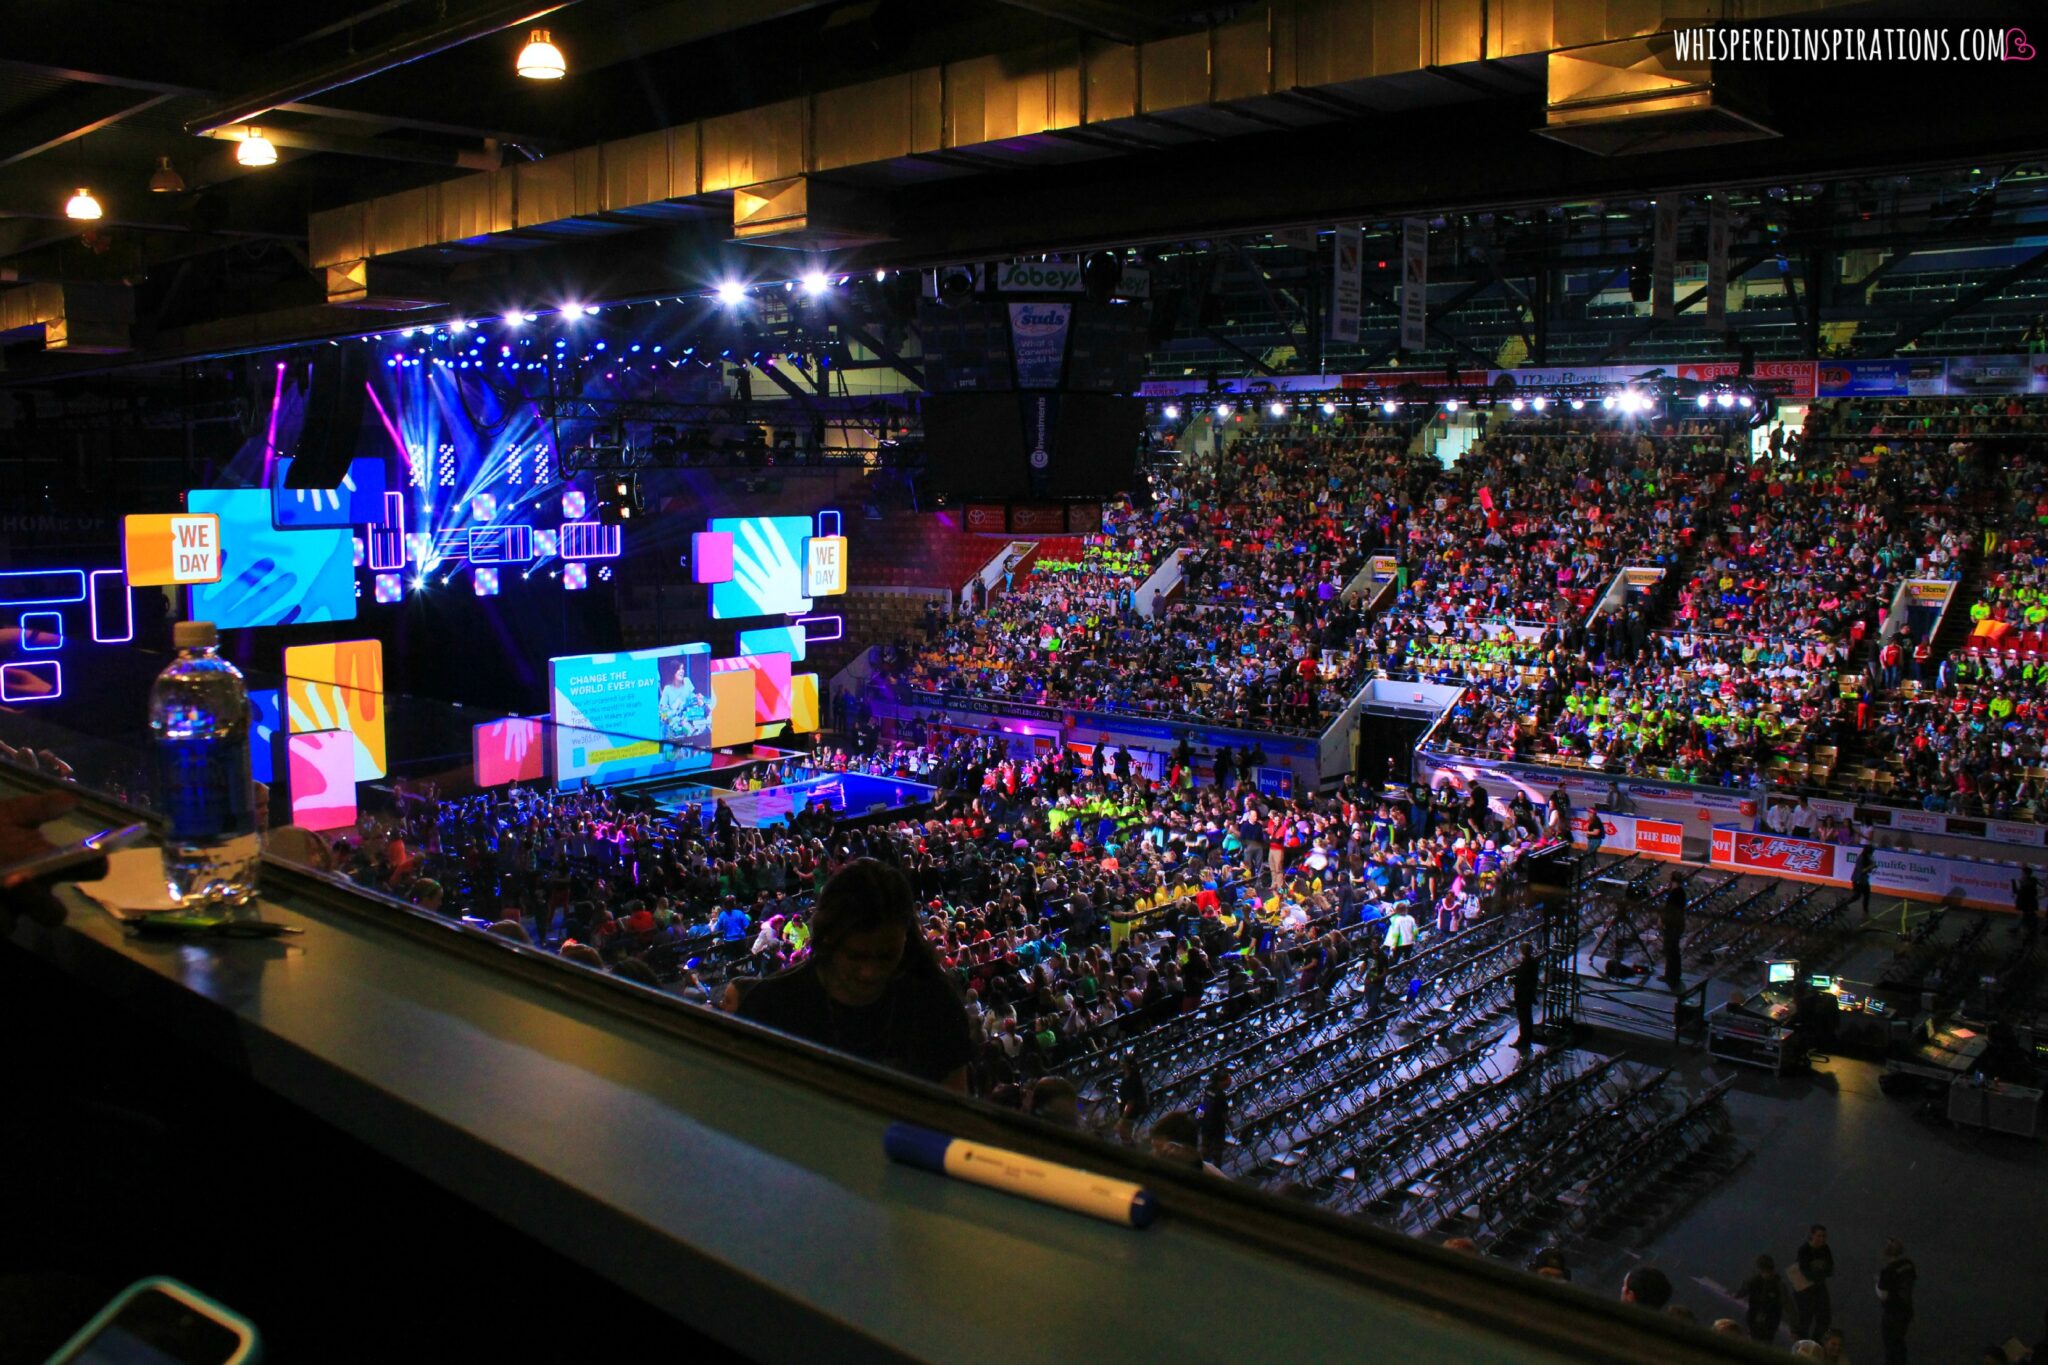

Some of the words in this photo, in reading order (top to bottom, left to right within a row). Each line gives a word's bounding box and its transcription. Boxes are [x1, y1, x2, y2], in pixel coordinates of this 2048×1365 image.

[1766, 362, 1812, 377] CLEAN
[1035, 396, 1046, 449] Investments
[178, 524, 209, 548] WE
[816, 546, 835, 565] WE
[180, 554, 209, 573] DAY
[816, 570, 835, 585] DAY
[570, 673, 607, 686] CHANGE
[610, 671, 627, 681] THE
[608, 680, 636, 691] EVERY
[638, 677, 655, 688] DAY
[1261, 778, 1278, 787] BMO
[1629, 783, 1666, 796] Gibson
[1637, 831, 1659, 842] THE
[1768, 840, 1825, 860] Hockey
[1909, 862, 1937, 876] Bank
